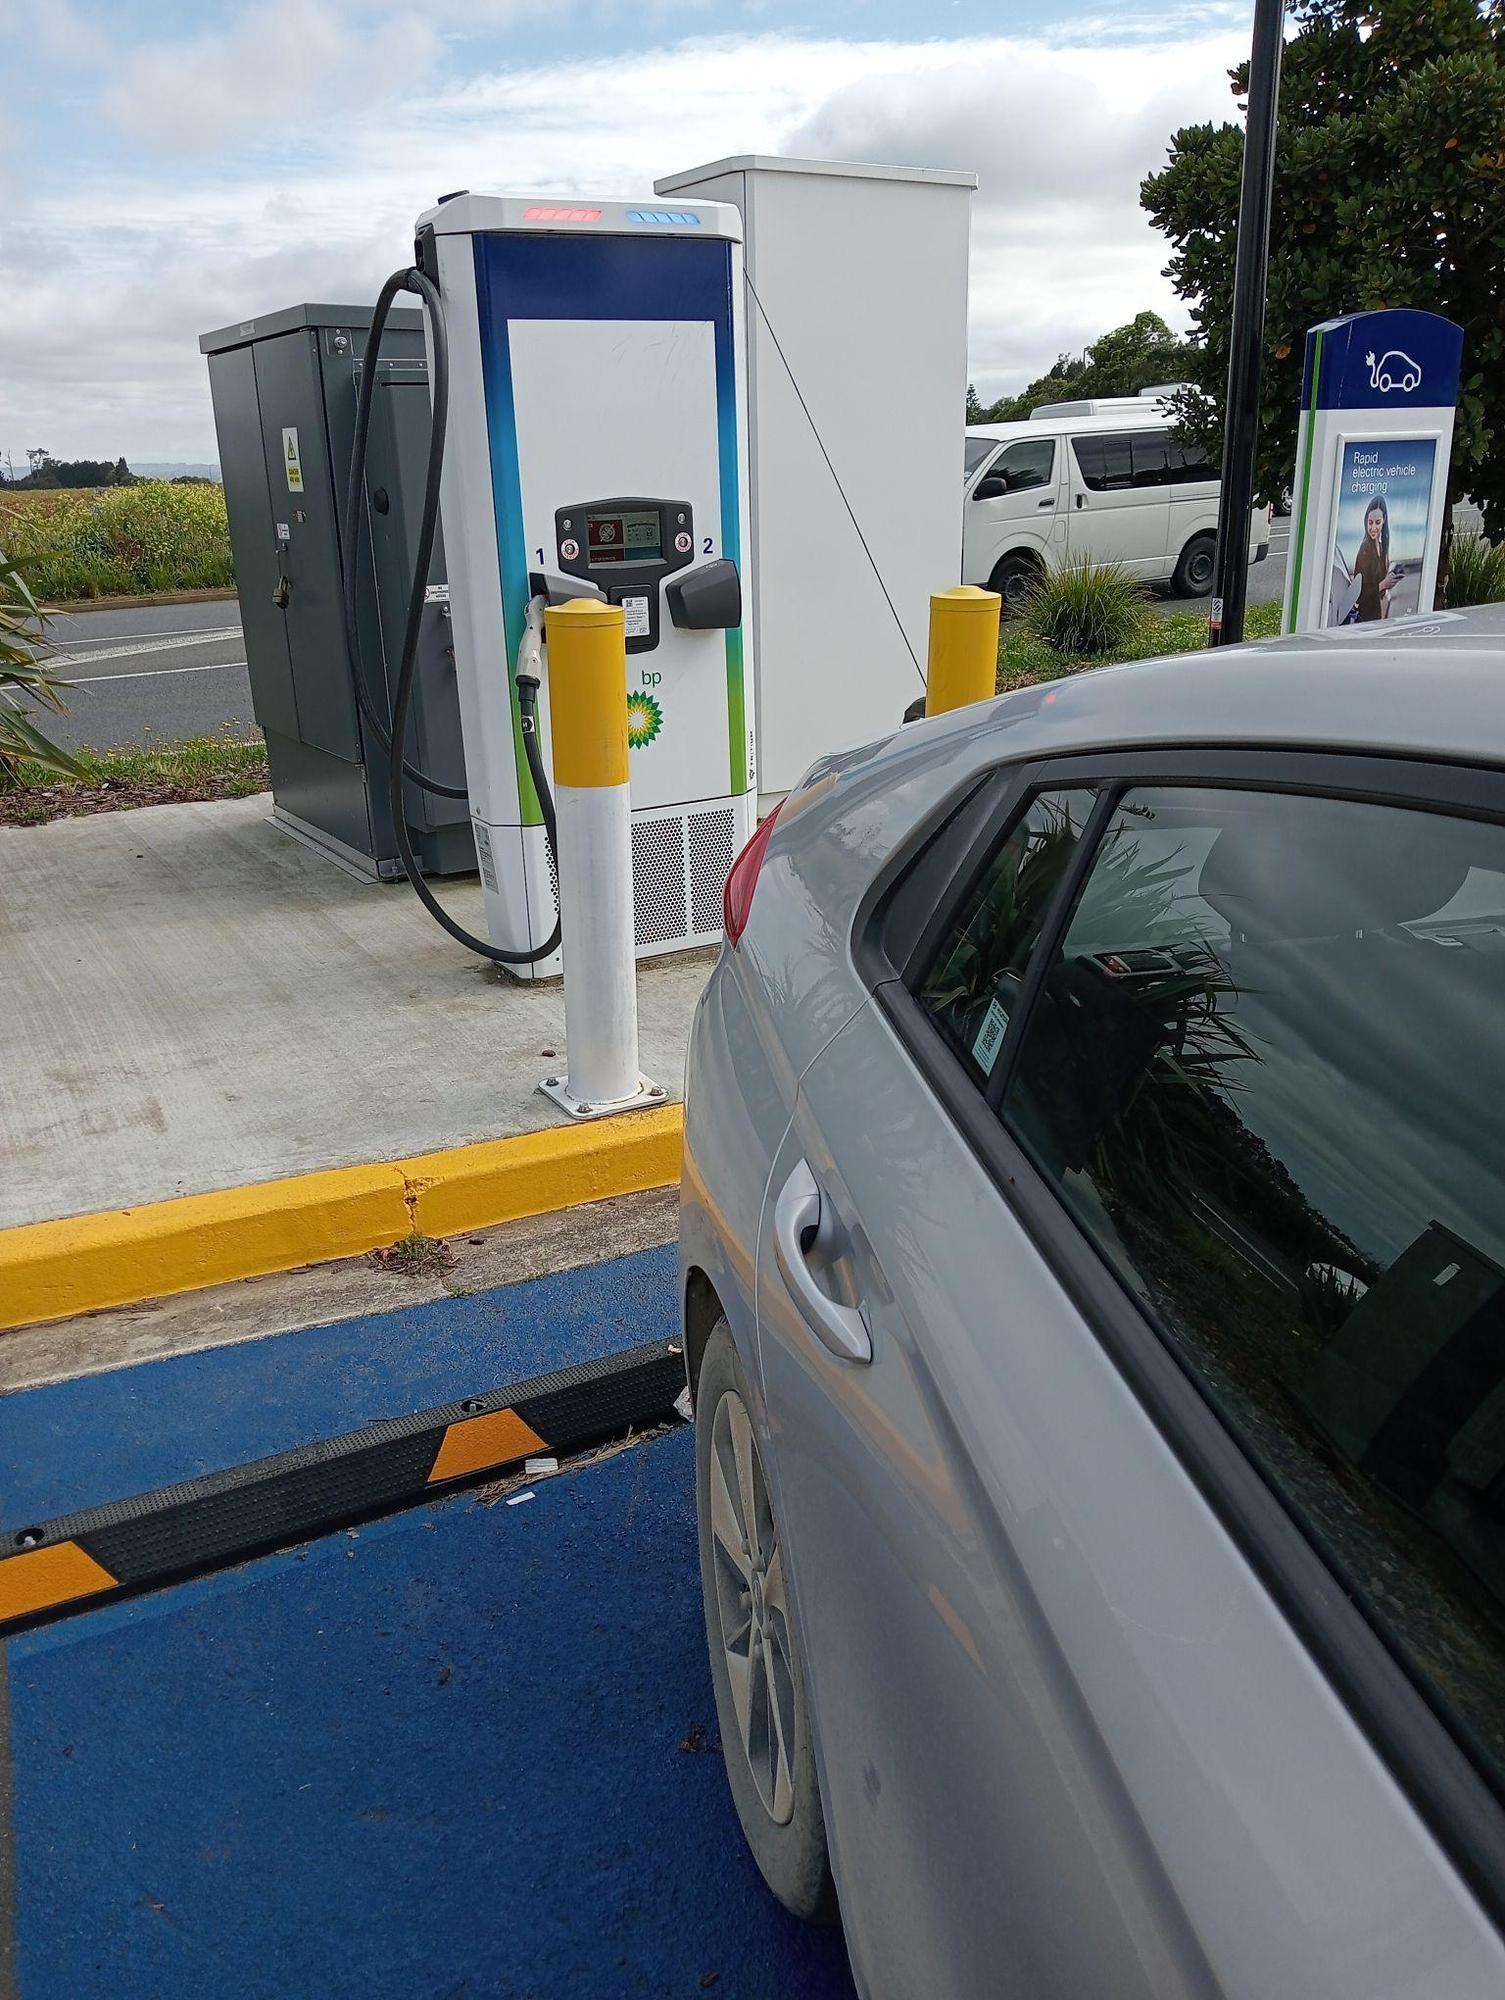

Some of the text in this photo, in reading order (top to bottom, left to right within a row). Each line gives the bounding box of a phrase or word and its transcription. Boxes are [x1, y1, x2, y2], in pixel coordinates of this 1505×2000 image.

[1353, 451, 1378, 465] Rapid
[1352, 464, 1416, 478] electric vehicle
[1351, 480, 1387, 494] charging
[703, 538, 714, 554] 2
[535, 548, 545, 565] 1
[641, 670, 662, 687] bp
